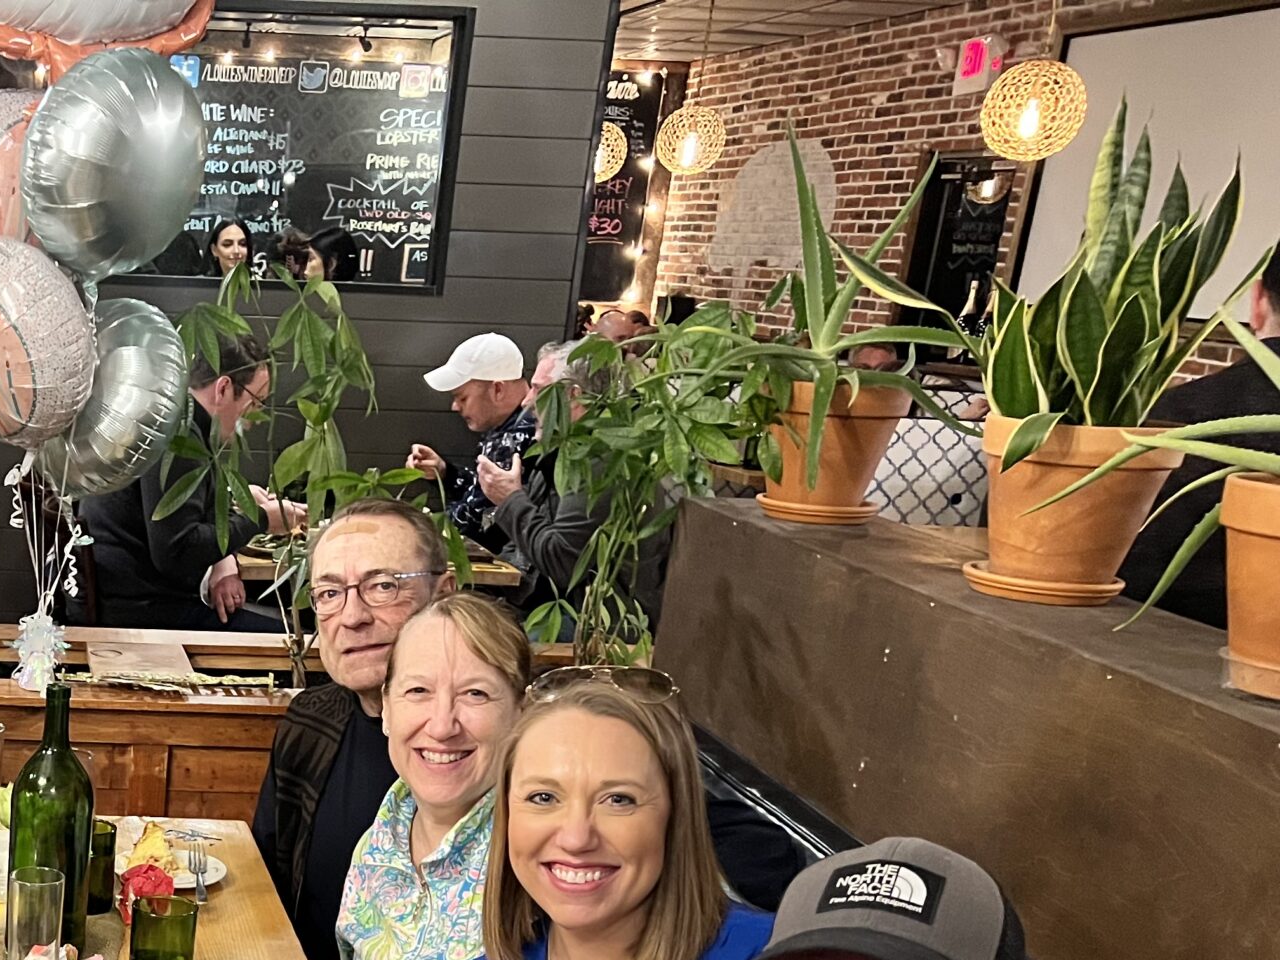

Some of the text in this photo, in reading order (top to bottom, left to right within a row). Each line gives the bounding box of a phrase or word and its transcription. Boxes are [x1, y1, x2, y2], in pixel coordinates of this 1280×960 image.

[365, 153, 410, 170] PRIME
[589, 215, 622, 235] $30
[865, 863, 900, 875] THE
[836, 873, 897, 888] NORTH
[847, 883, 893, 896] FACE
[876, 895, 923, 914] Equipment
